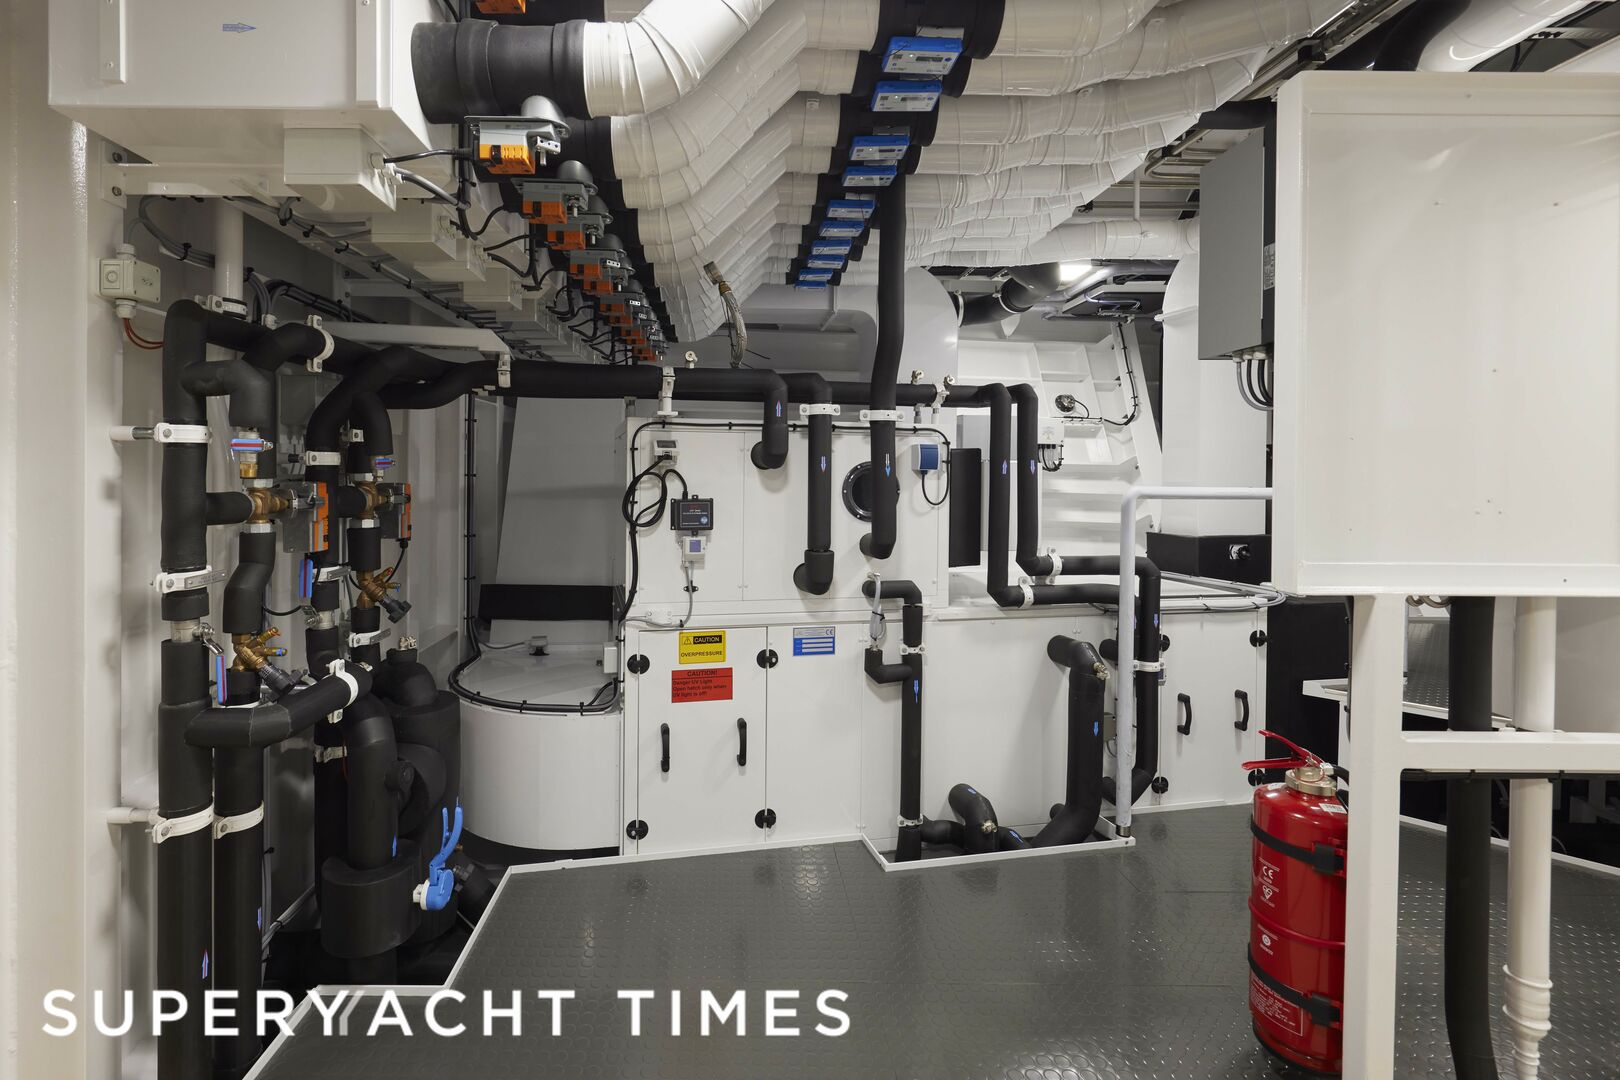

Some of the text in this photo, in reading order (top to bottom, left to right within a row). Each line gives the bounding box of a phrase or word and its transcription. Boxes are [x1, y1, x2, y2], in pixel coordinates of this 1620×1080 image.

[694, 636, 720, 644] CAUTION
[680, 650, 723, 658] OVERPRESSURE
[1262, 866, 1274, 879] CE
